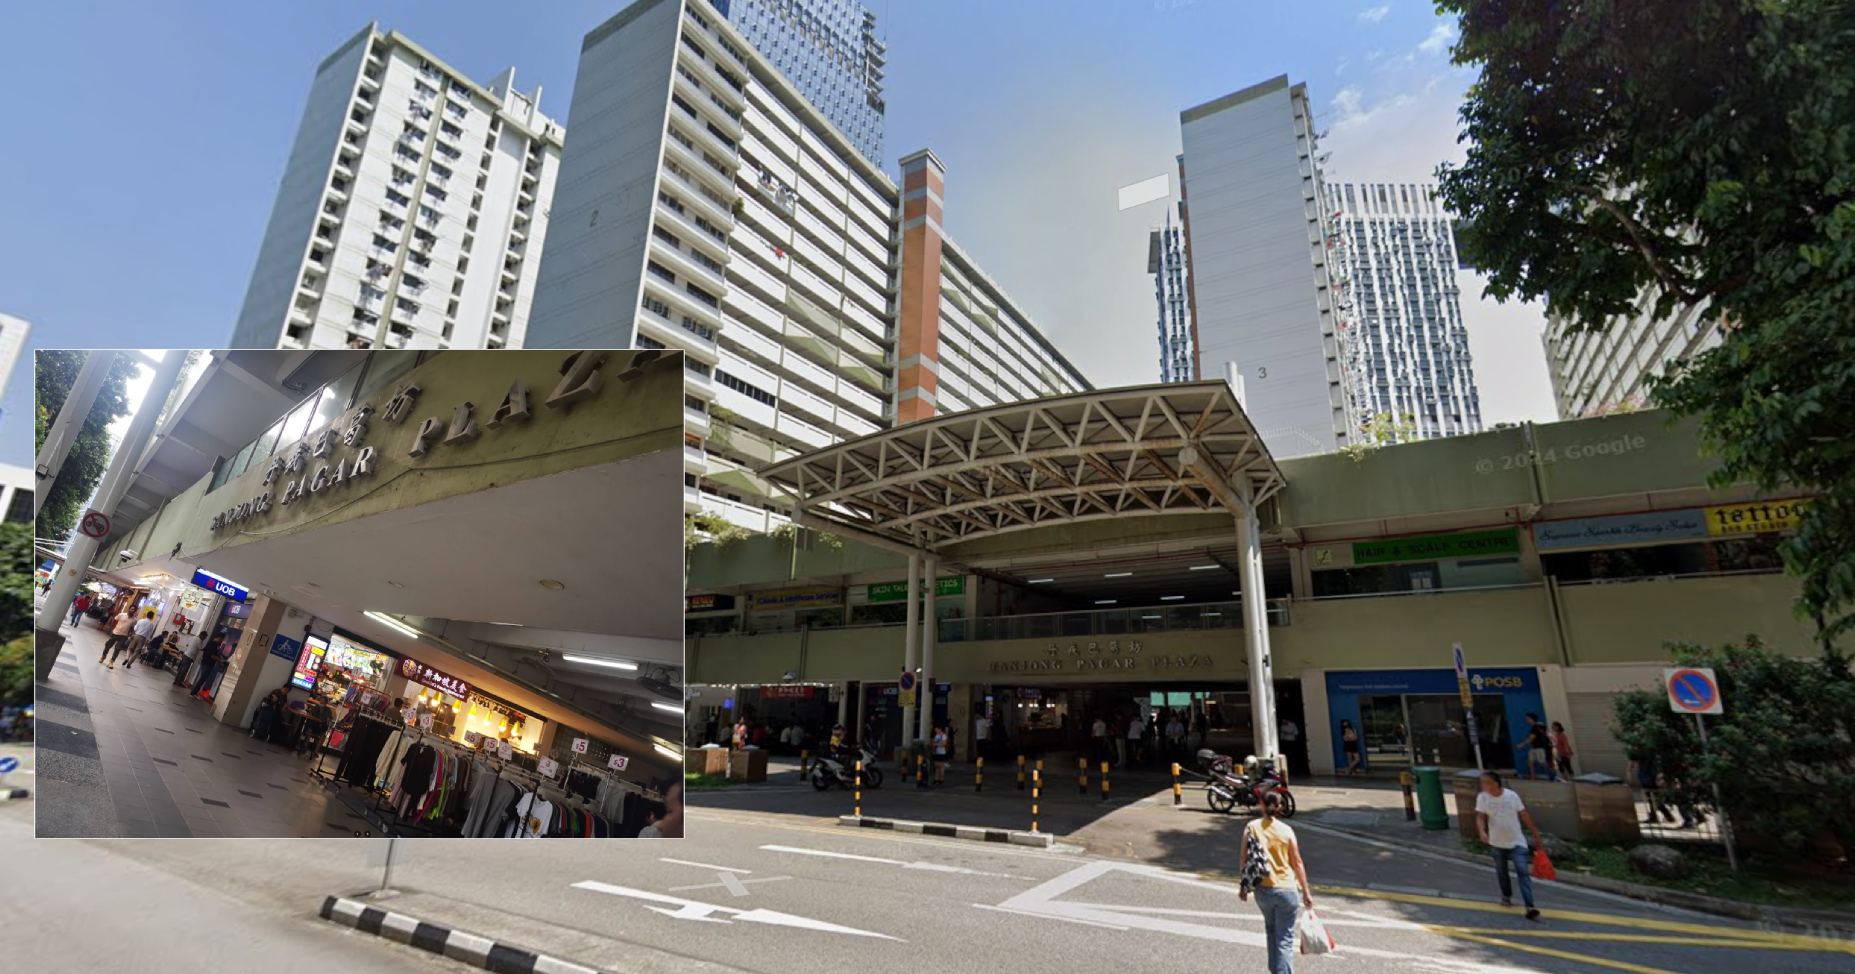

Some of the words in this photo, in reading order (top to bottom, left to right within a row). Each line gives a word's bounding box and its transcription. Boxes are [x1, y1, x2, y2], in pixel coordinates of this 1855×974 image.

[590, 210, 599, 227] 2
[1258, 366, 1268, 379] 3
[408, 350, 683, 458] PLAZ
[210, 491, 274, 531] TANJONG
[281, 446, 376, 505] PAGAR
[1357, 547, 1385, 558] HAIR
[1410, 543, 1450, 555] SCALP
[1459, 537, 1513, 550] CENTRE
[216, 582, 236, 597] UOB
[991, 659, 1062, 672] TANJONG
[1076, 658, 1136, 670] PAGAR
[1151, 655, 1214, 668] PLAZA
[423, 668, 467, 694] 新加坡美食
[1484, 677, 1523, 688] POSB
[883, 687, 898, 695] UOB
[422, 716, 430, 726] $3
[467, 734, 476, 742] $5
[486, 740, 496, 749] $5
[575, 741, 586, 752] $5
[613, 758, 625, 768] $3
